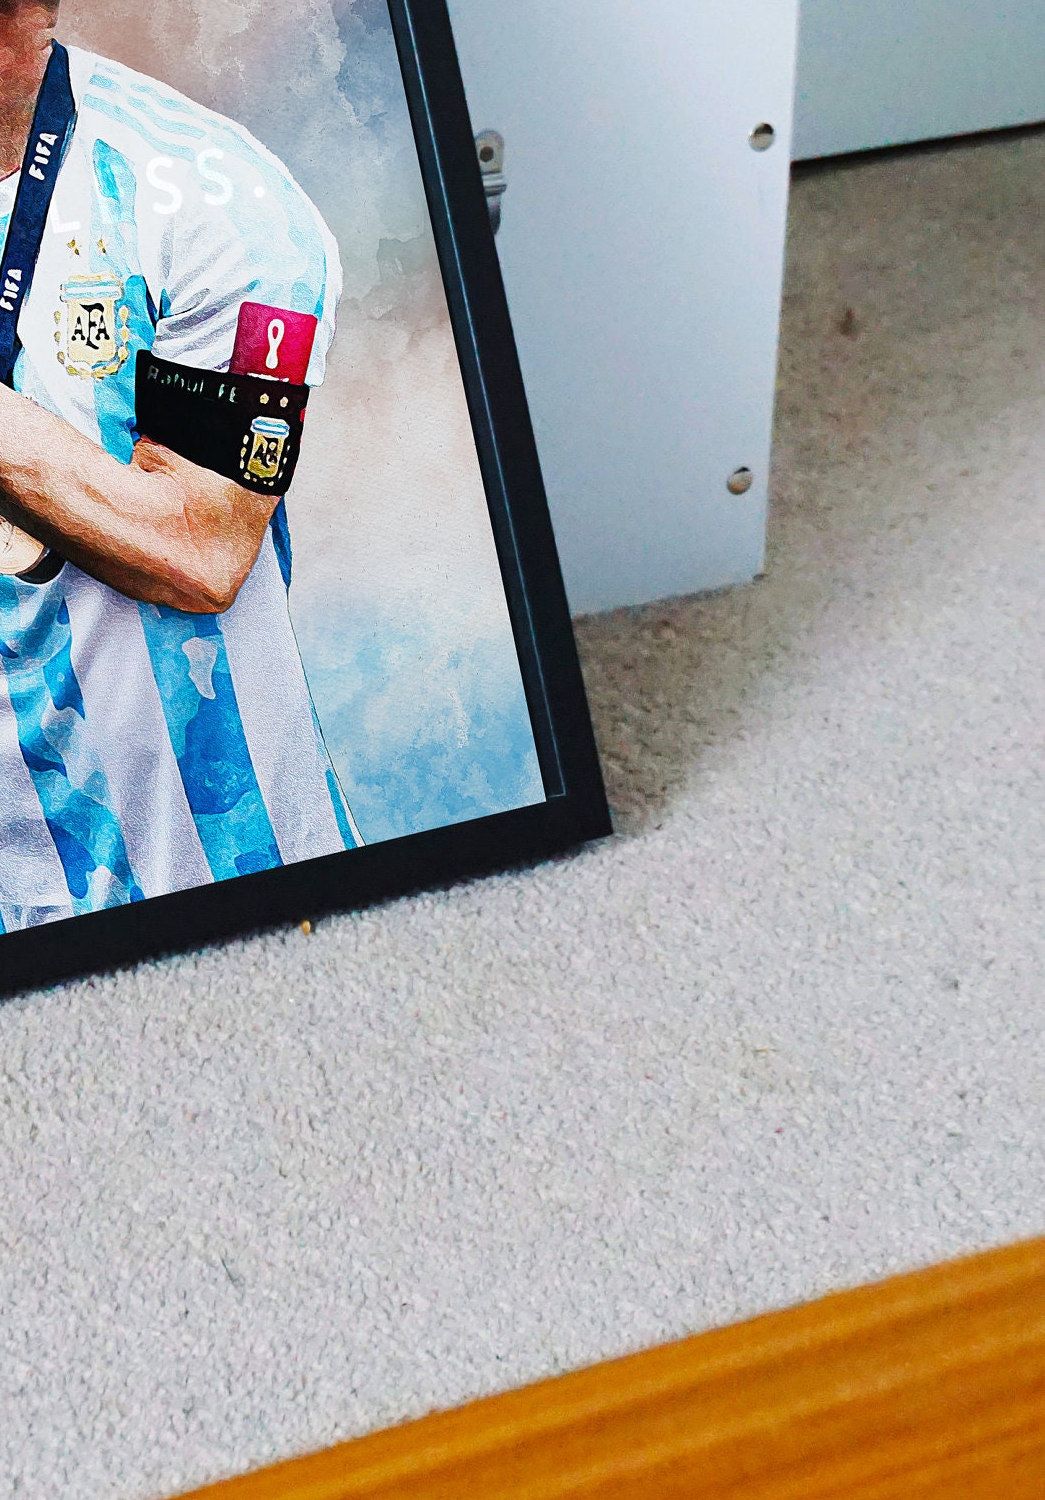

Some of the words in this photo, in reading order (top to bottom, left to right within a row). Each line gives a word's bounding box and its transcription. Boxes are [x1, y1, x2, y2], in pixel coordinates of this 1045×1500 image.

[28, 132, 59, 181] FIFA
[0, 268, 23, 311] FIFA
[71, 303, 110, 350] AFA
